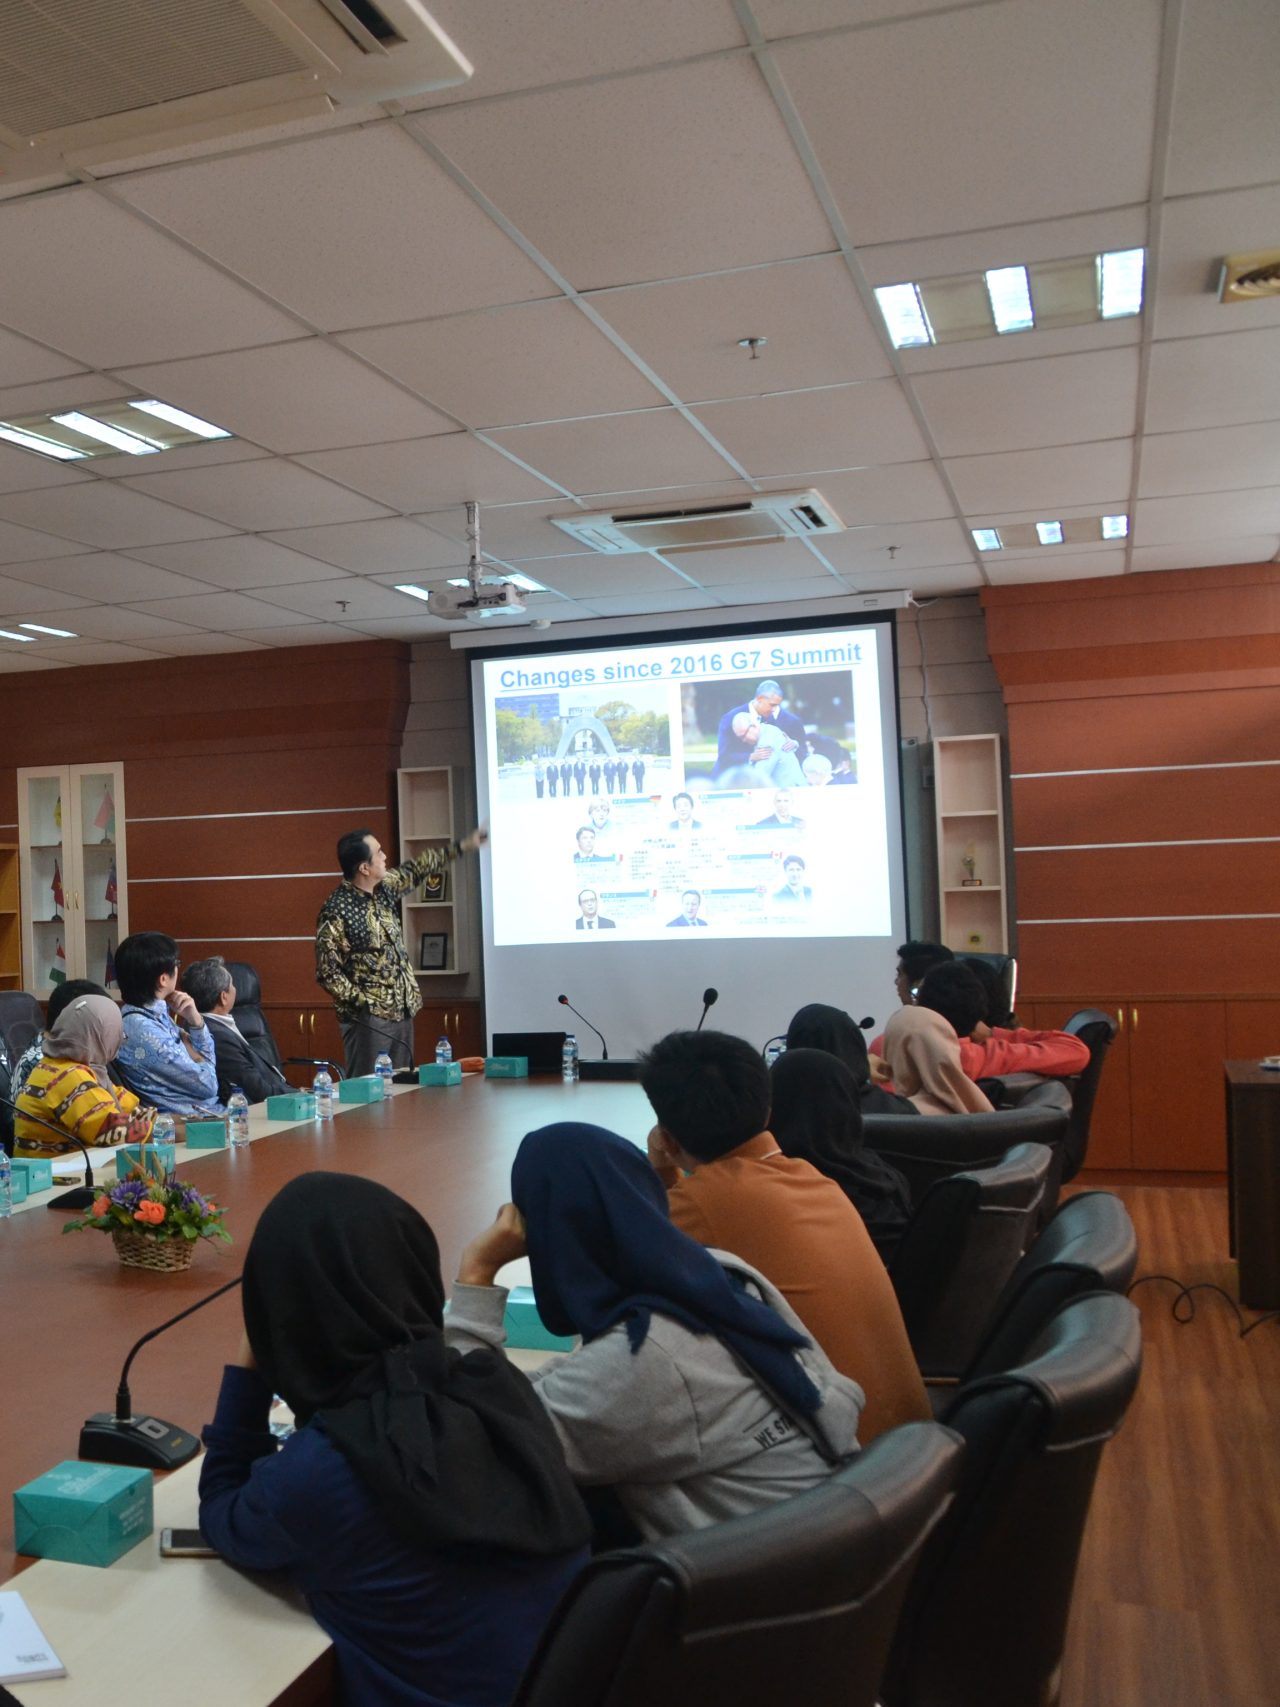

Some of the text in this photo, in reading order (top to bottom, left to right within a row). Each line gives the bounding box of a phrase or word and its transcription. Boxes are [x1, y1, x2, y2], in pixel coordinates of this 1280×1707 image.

[500, 643, 862, 688] Changes since 2016 G7 Summit
[754, 1426, 778, 1449] WE
